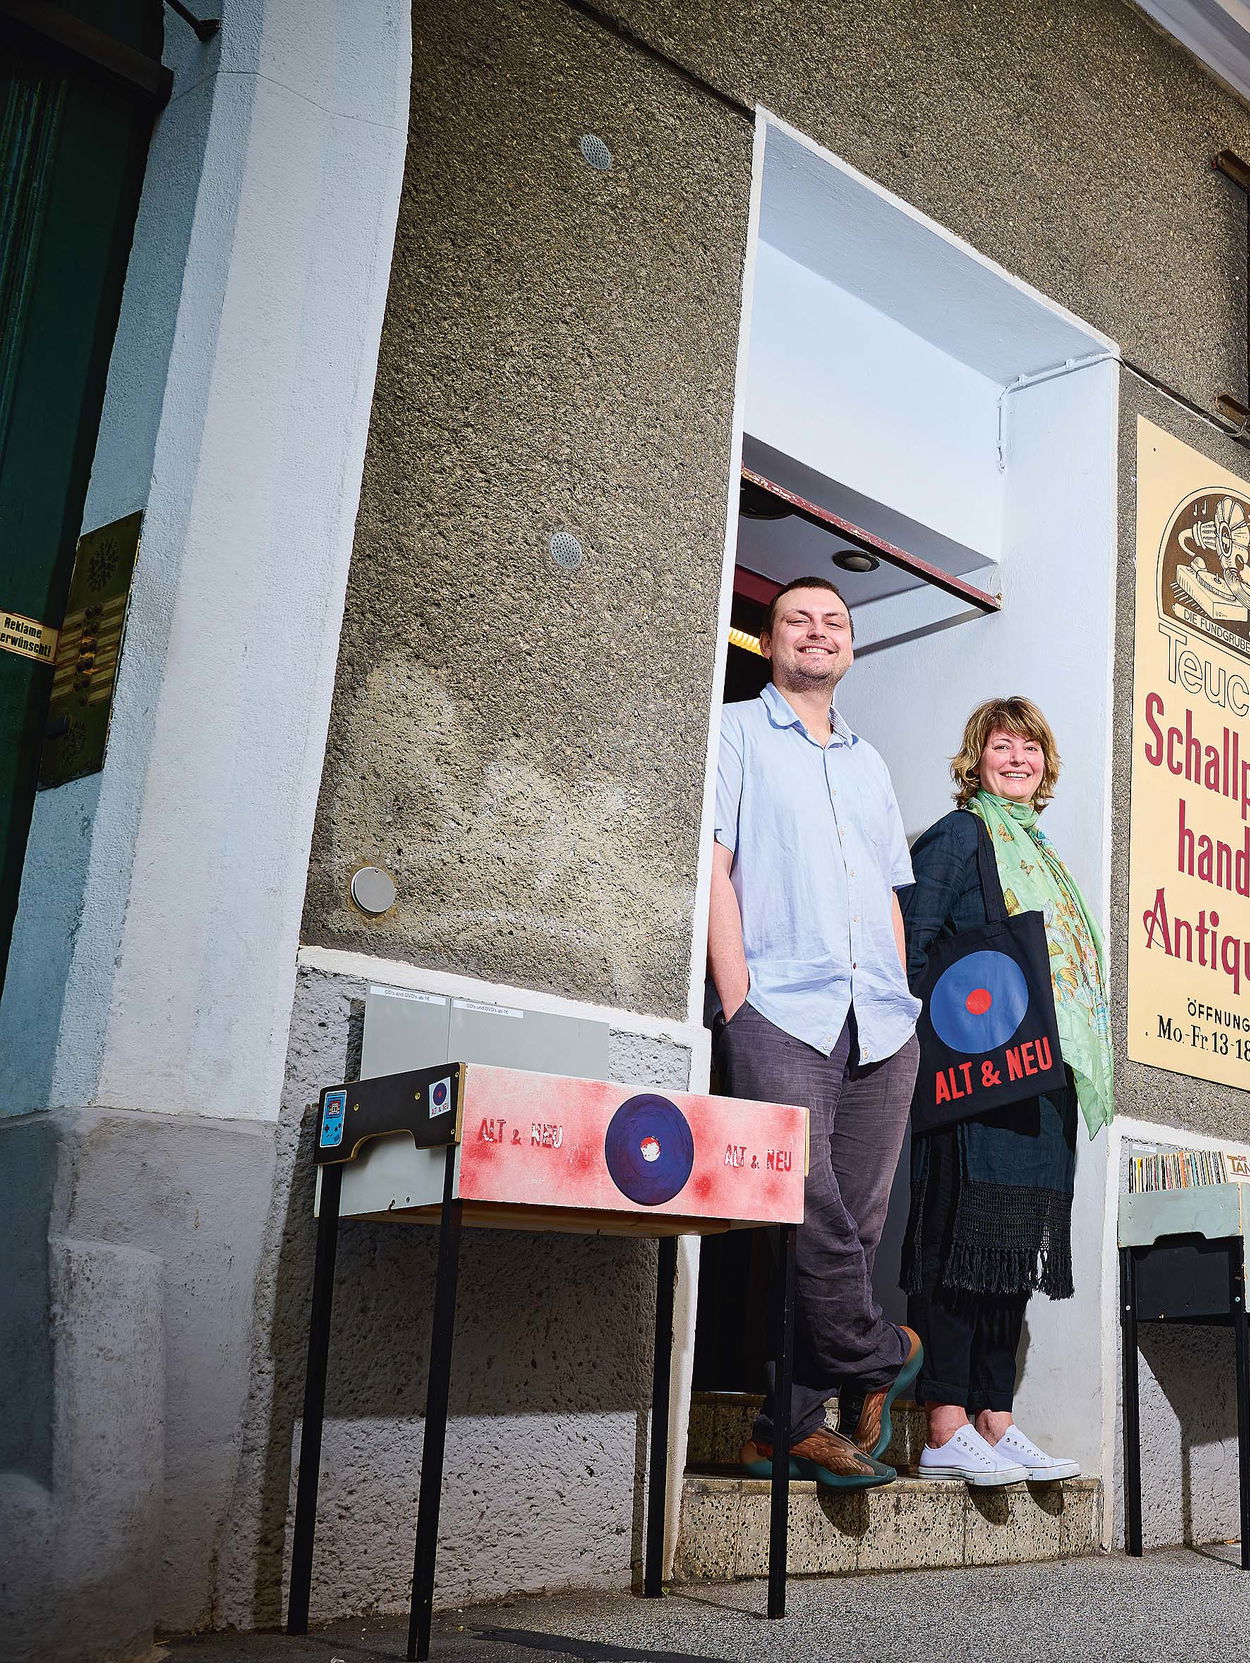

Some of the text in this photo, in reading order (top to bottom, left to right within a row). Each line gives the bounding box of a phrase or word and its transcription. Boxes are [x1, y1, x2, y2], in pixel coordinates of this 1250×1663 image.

[4, 616, 42, 639] Reklame
[1184, 609, 1198, 625] DIE
[1200, 618, 1250, 653] FUNDGRUBE
[935, 1036, 1053, 1105] ALT & NEU
[477, 1118, 564, 1149] ALT & NEU
[723, 1144, 793, 1172] ALT & NEU
